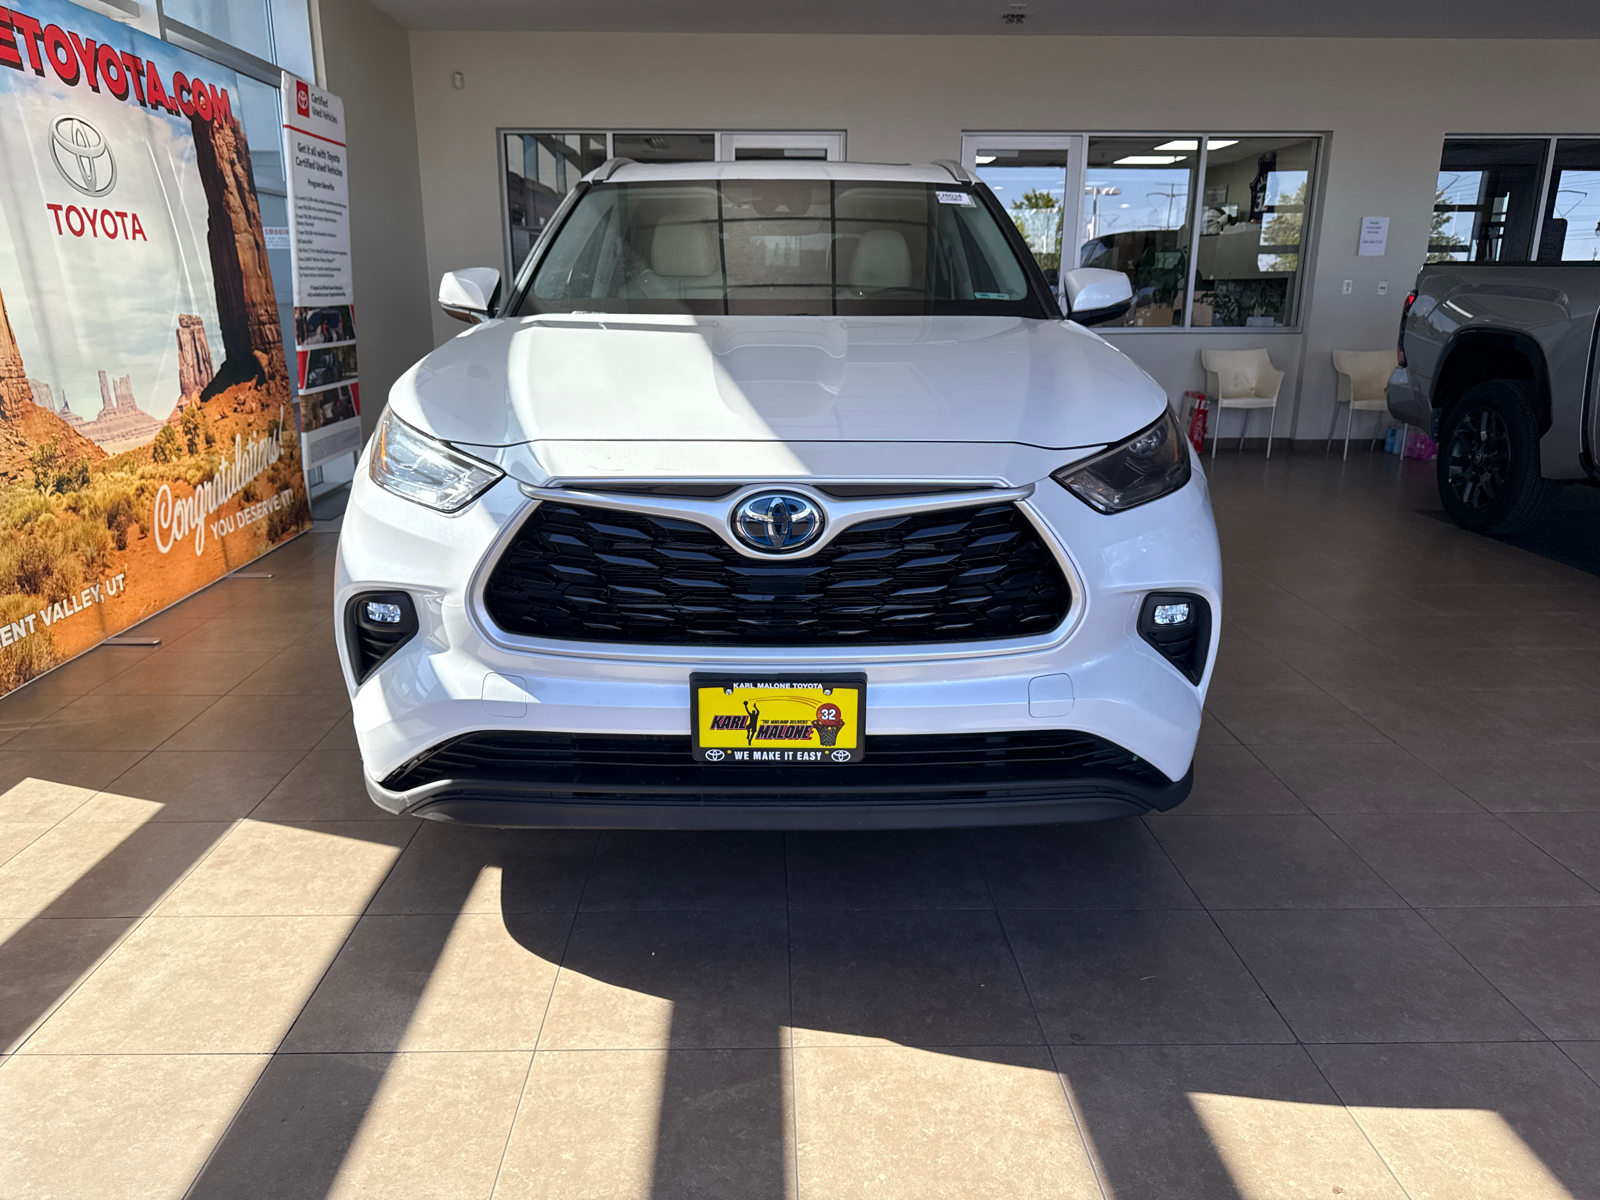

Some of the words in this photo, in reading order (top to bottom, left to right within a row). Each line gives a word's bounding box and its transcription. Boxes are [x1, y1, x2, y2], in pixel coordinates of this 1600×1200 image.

[311, 93, 328, 108] Certified
[297, 142, 306, 154] Get
[296, 156, 315, 170] Certified
[47, 203, 148, 242] TOYOTA
[154, 404, 286, 557] Congratulations!
[210, 515, 235, 540] YOU
[235, 494, 281, 529] DESERVE
[280, 488, 295, 508] IT!
[0, 613, 36, 650] ENT
[40, 583, 105, 627] VALLEY,
[105, 572, 125, 596] UT
[821, 708, 837, 720] 32
[710, 715, 749, 730] KARL
[755, 725, 814, 740] MALONE
[734, 751, 750, 760] WE
[753, 751, 781, 760] MAKE
[784, 751, 796, 760] IT
[796, 751, 822, 760] EASY
